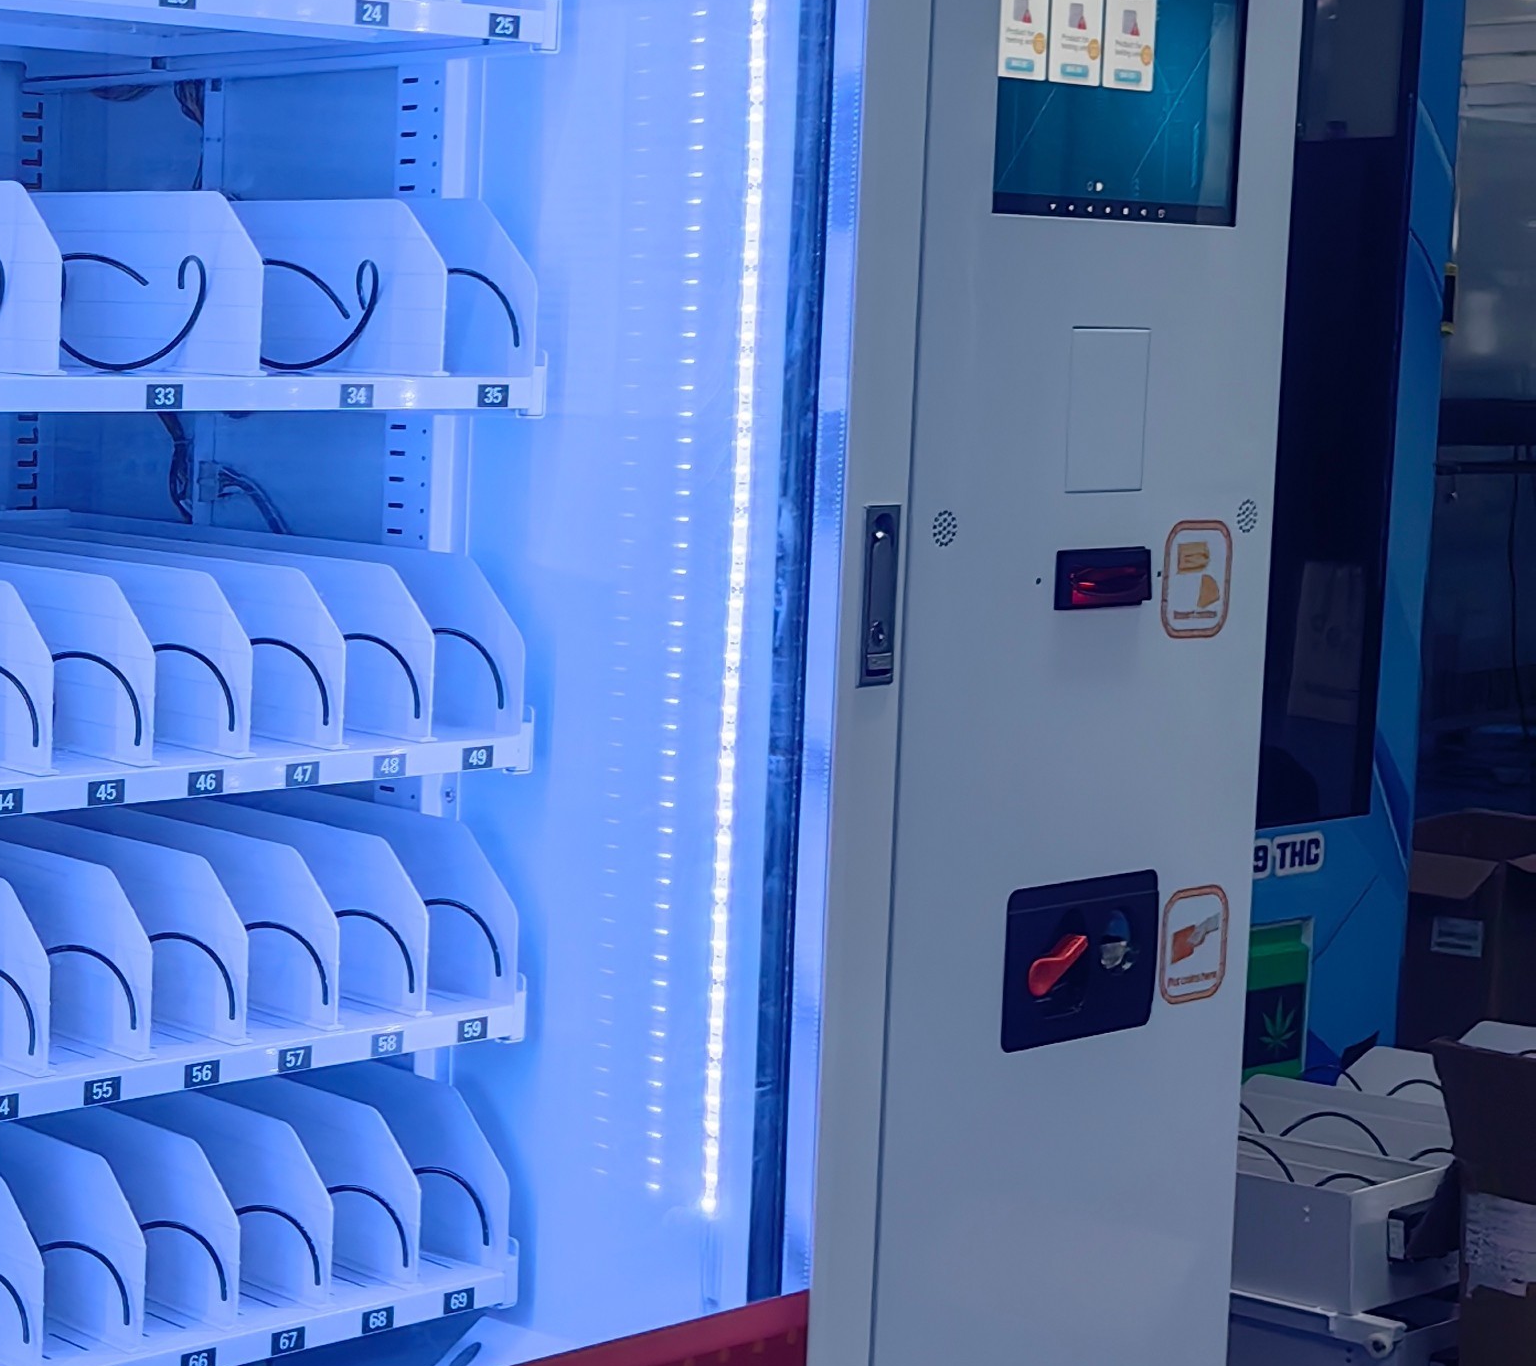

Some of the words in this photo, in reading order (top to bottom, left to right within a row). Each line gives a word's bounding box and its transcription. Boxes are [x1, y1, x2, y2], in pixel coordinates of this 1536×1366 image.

[362, 3, 382, 22] 24
[494, 16, 514, 35] 25
[154, 387, 175, 406] 33
[347, 386, 367, 405] 34
[483, 386, 503, 404] 35
[95, 782, 117, 801] 45
[195, 773, 217, 791] 46
[293, 764, 313, 782] 47
[380, 756, 400, 774] 48
[468, 748, 487, 766] 49
[1276, 837, 1321, 869] THC
[92, 1080, 113, 1100] 55
[192, 1064, 212, 1083] 56
[285, 1049, 305, 1068] 57
[378, 1034, 397, 1053] 58
[463, 1020, 482, 1038] 59
[279, 1331, 298, 1350] 67
[369, 1310, 387, 1329] 68
[450, 1291, 468, 1310] 69
